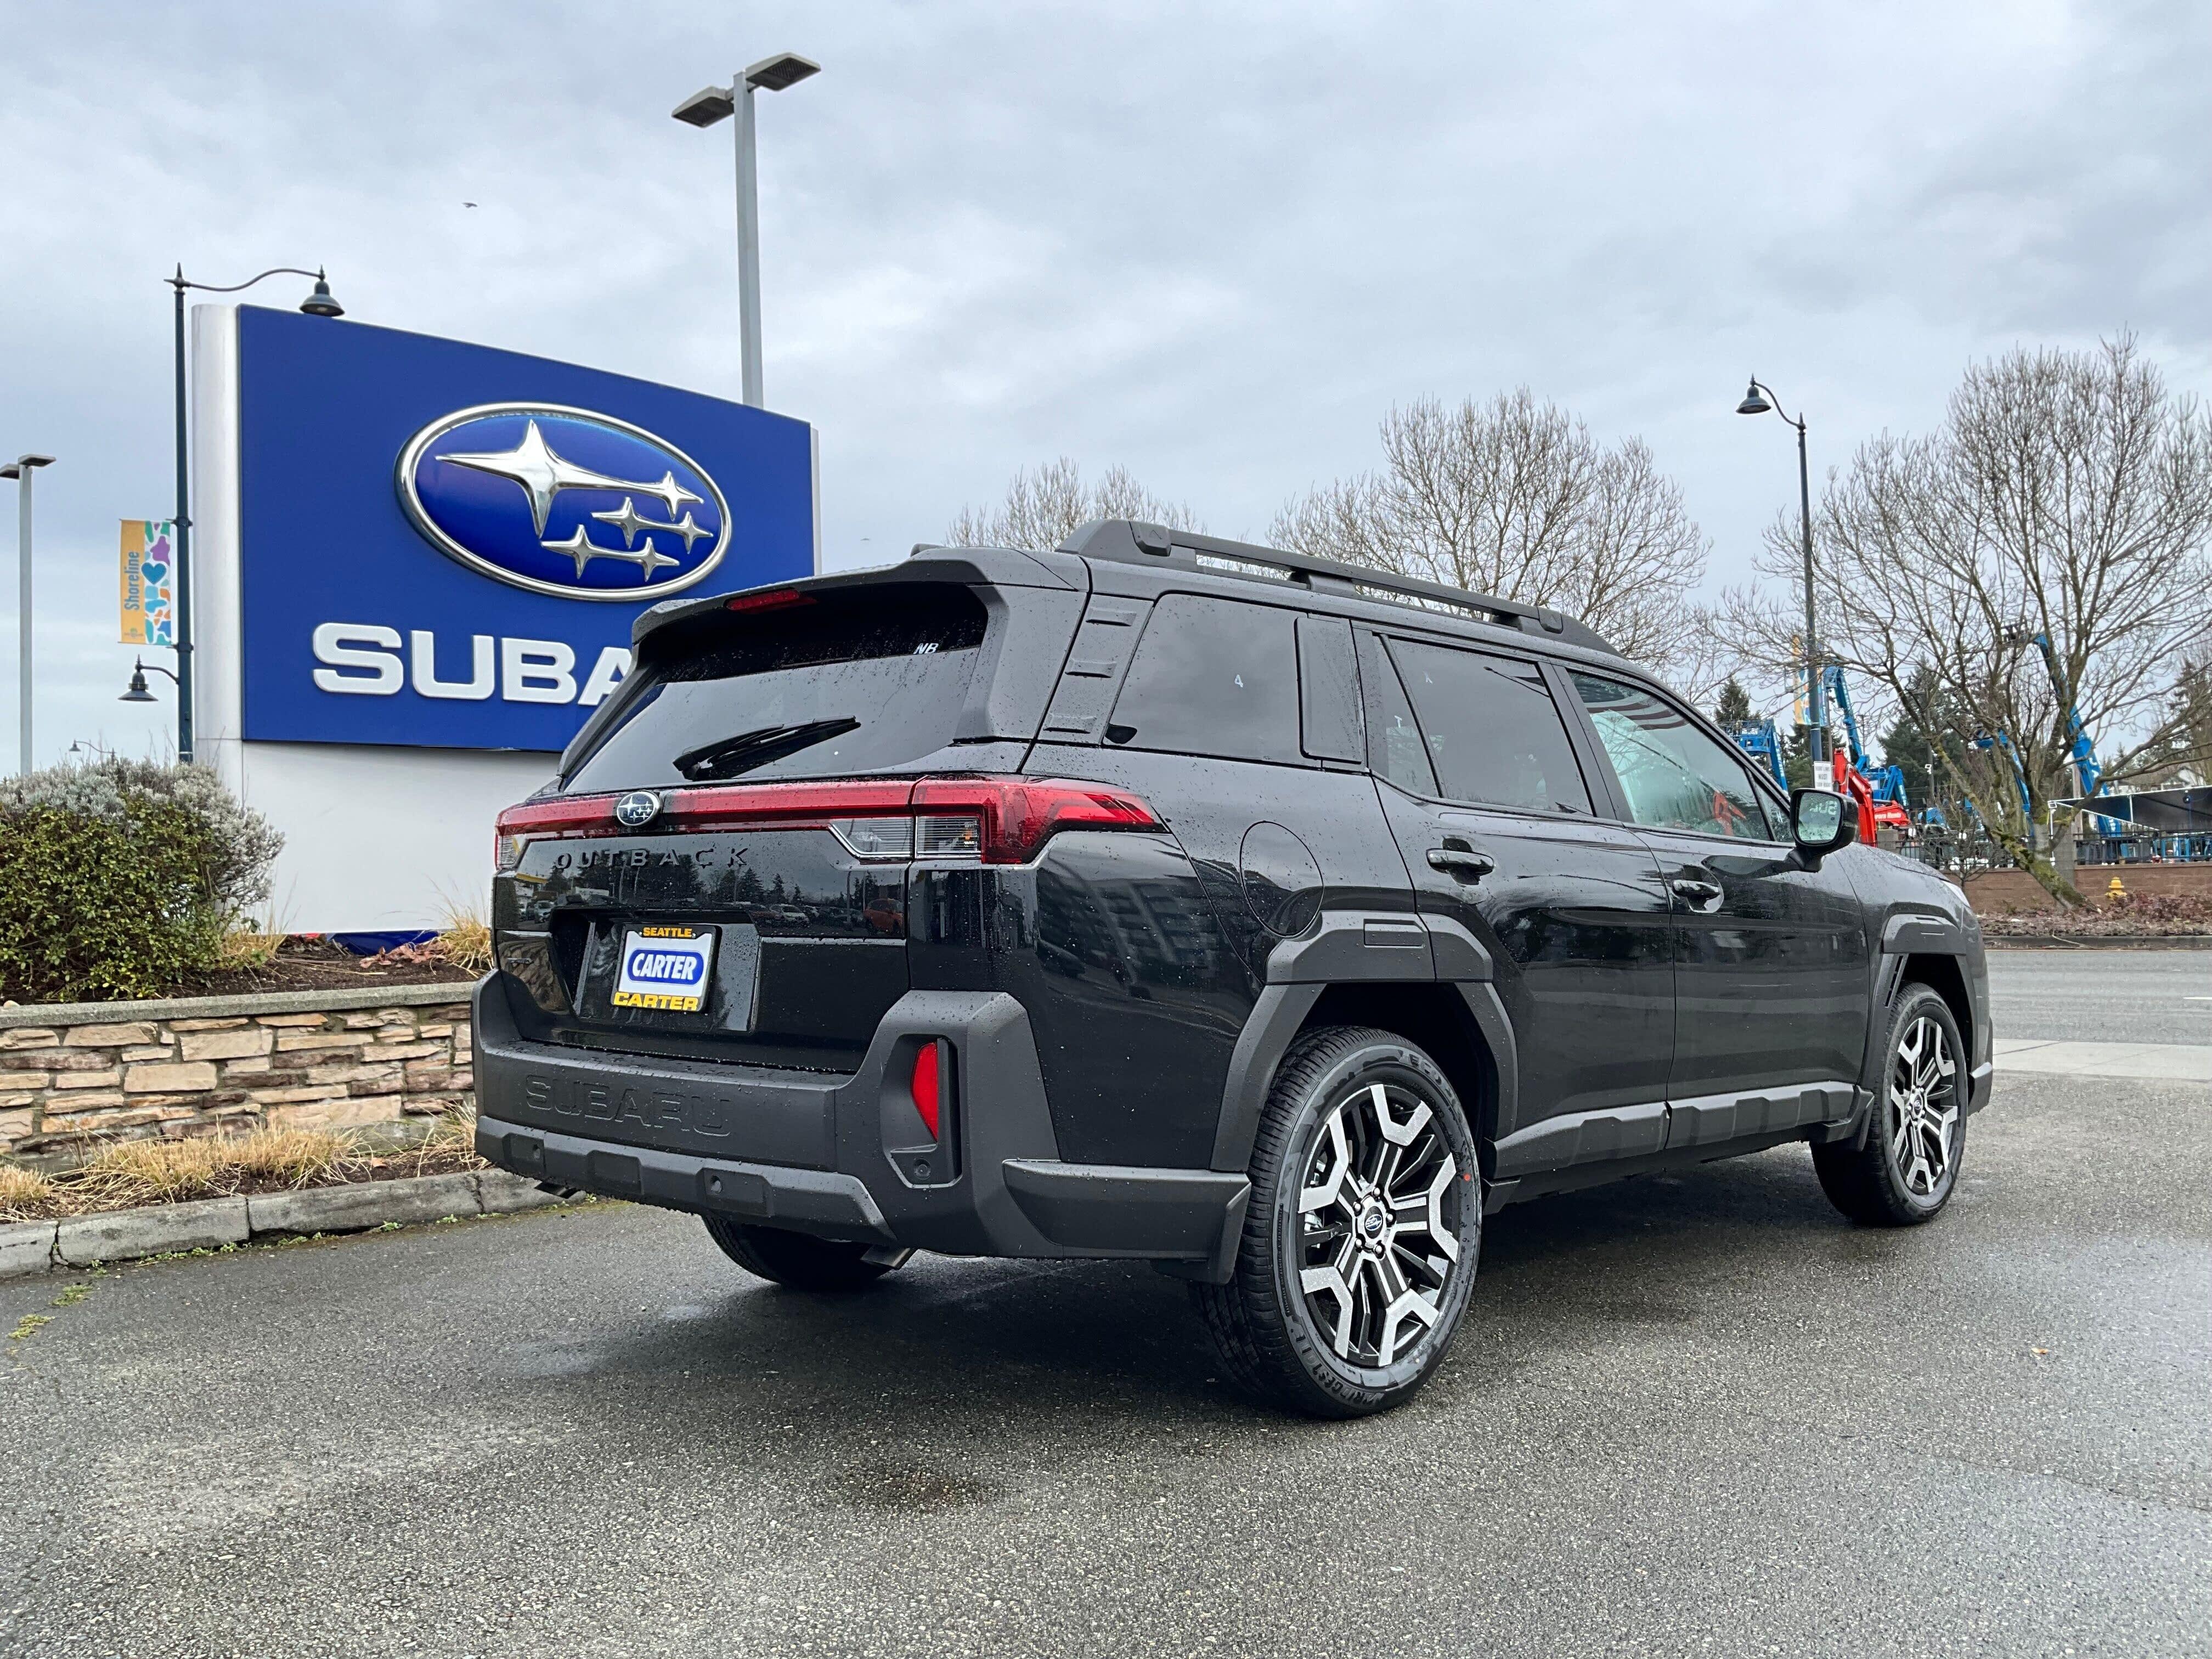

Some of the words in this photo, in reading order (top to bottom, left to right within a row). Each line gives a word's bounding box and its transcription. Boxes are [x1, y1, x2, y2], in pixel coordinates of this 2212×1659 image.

[124, 551, 139, 610] Shoreline
[555, 848, 748, 870] OUTBACK
[642, 927, 693, 938] SEATTLE
[631, 952, 697, 980] CARTER
[613, 991, 698, 1011] CARTER
[526, 1074, 731, 1137] SUBARU
